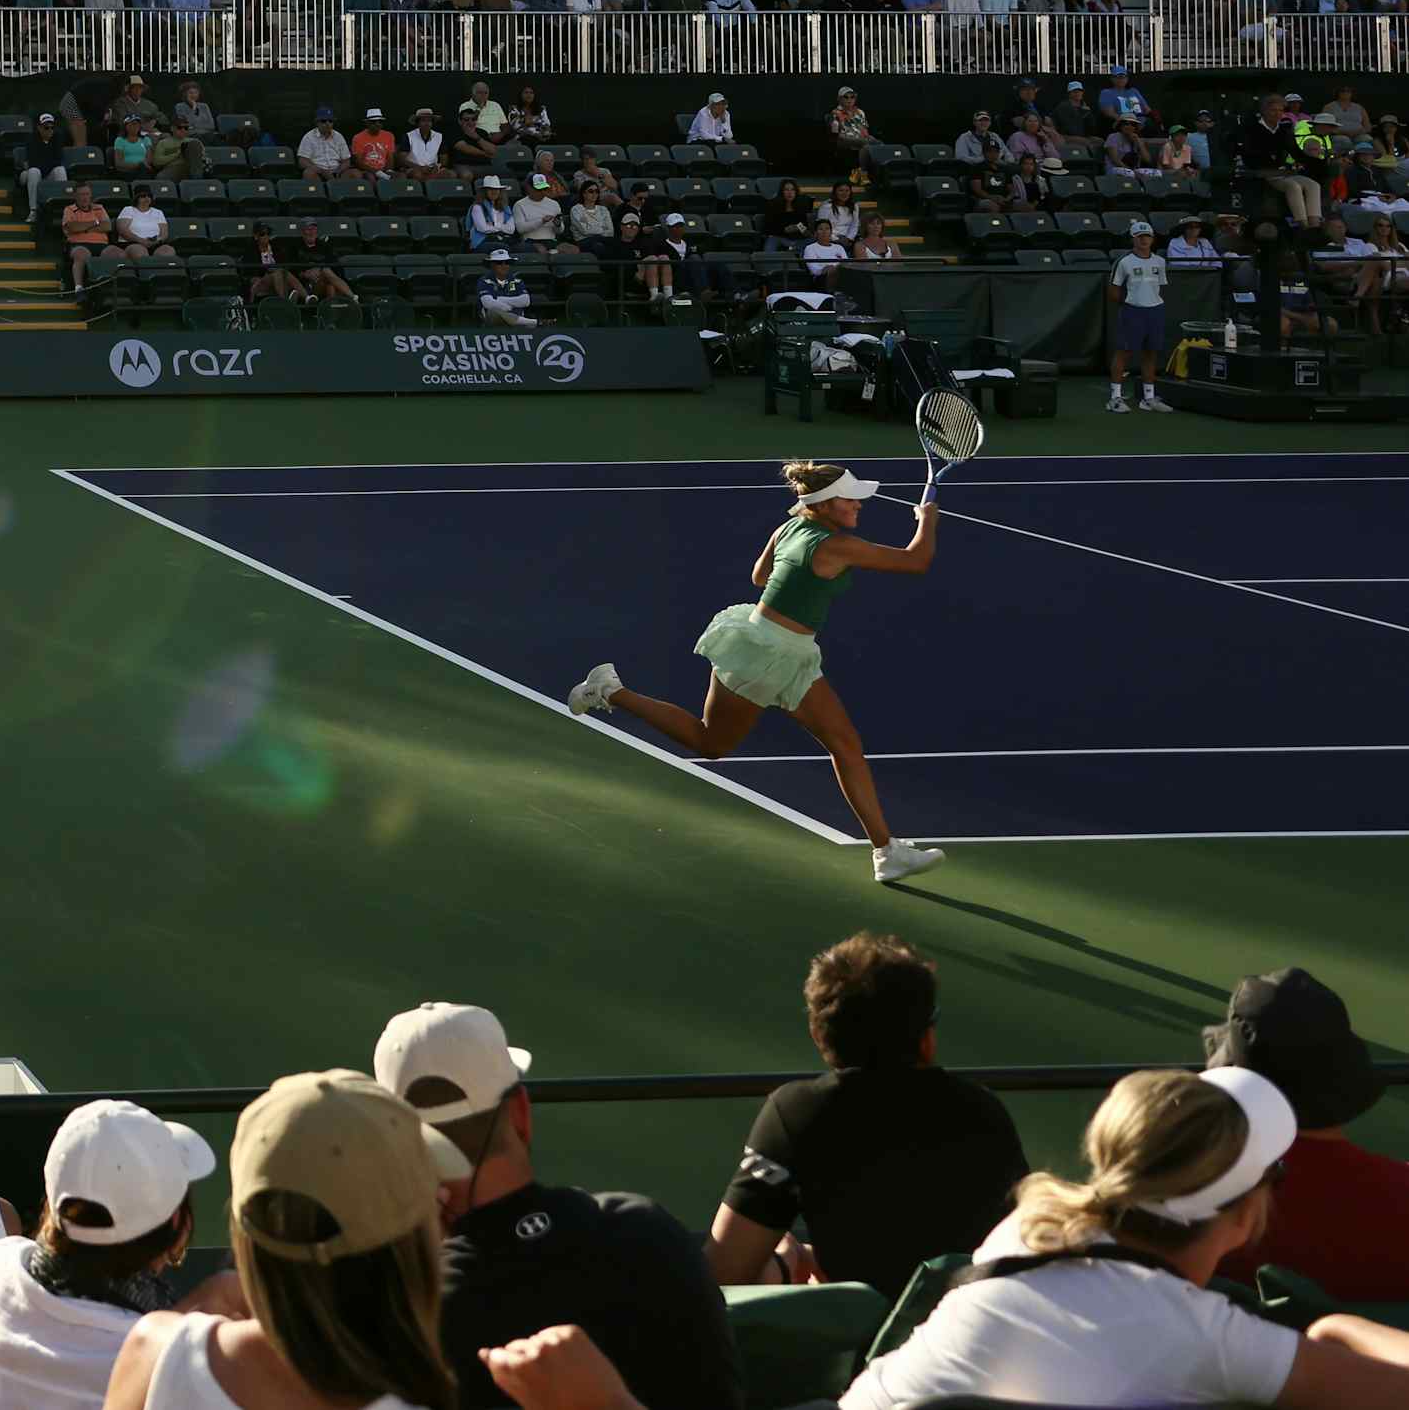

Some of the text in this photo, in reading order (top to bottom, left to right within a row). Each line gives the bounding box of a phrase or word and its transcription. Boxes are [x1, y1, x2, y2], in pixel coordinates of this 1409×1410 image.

[393, 334, 533, 353] SPOTLIGHT
[173, 348, 261, 377] razr
[422, 353, 515, 372] CASINO
[504, 374, 524, 384] CA
